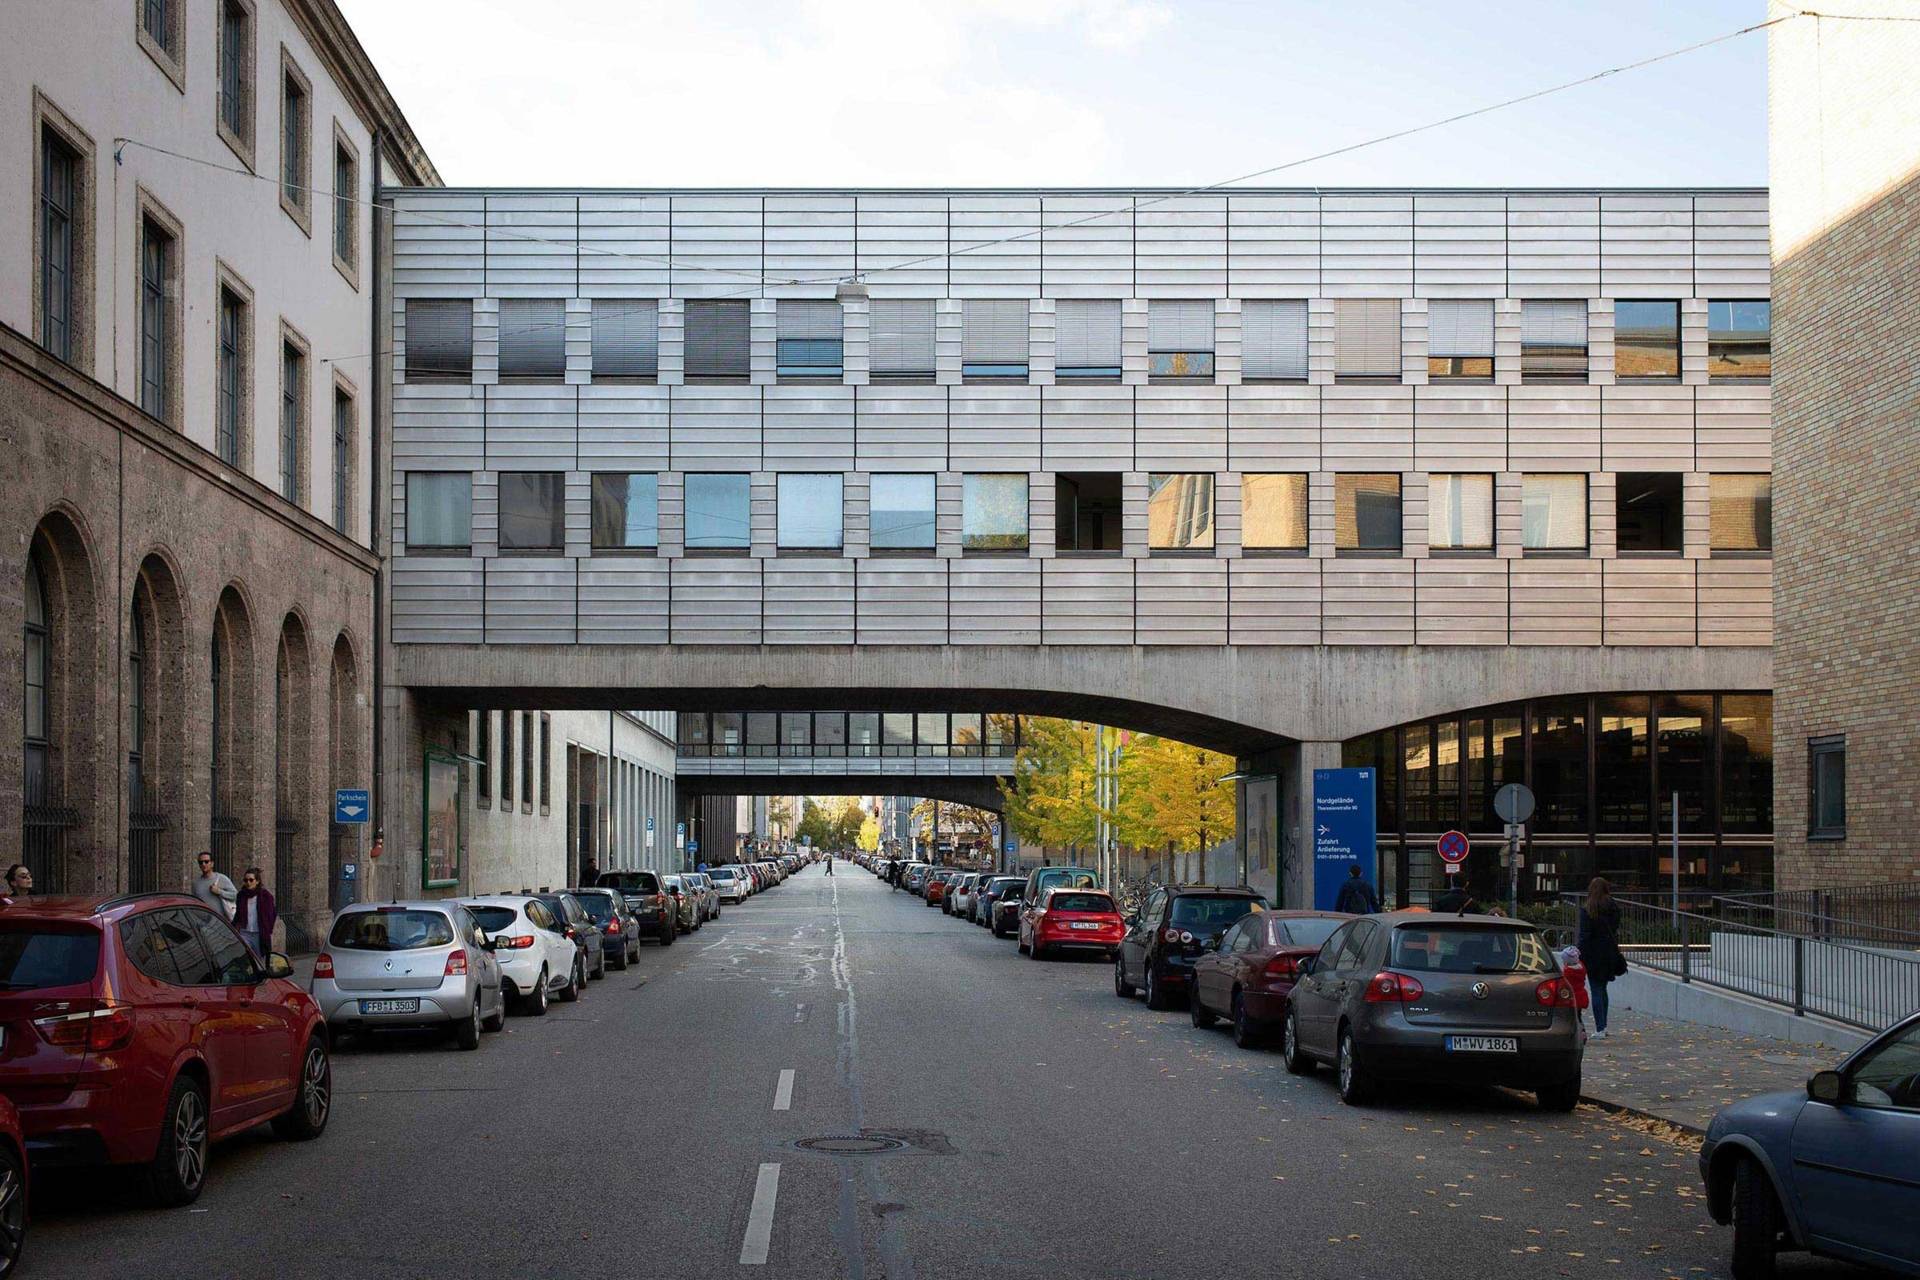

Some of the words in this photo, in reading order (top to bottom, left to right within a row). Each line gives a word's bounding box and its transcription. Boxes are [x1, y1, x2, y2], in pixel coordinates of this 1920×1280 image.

[367, 1001, 383, 1011] FFB
[395, 1000, 415, 1010] 3503
[1453, 1039, 1462, 1049] M
[1469, 1039, 1485, 1049] WV
[1487, 1039, 1516, 1051] 1861
